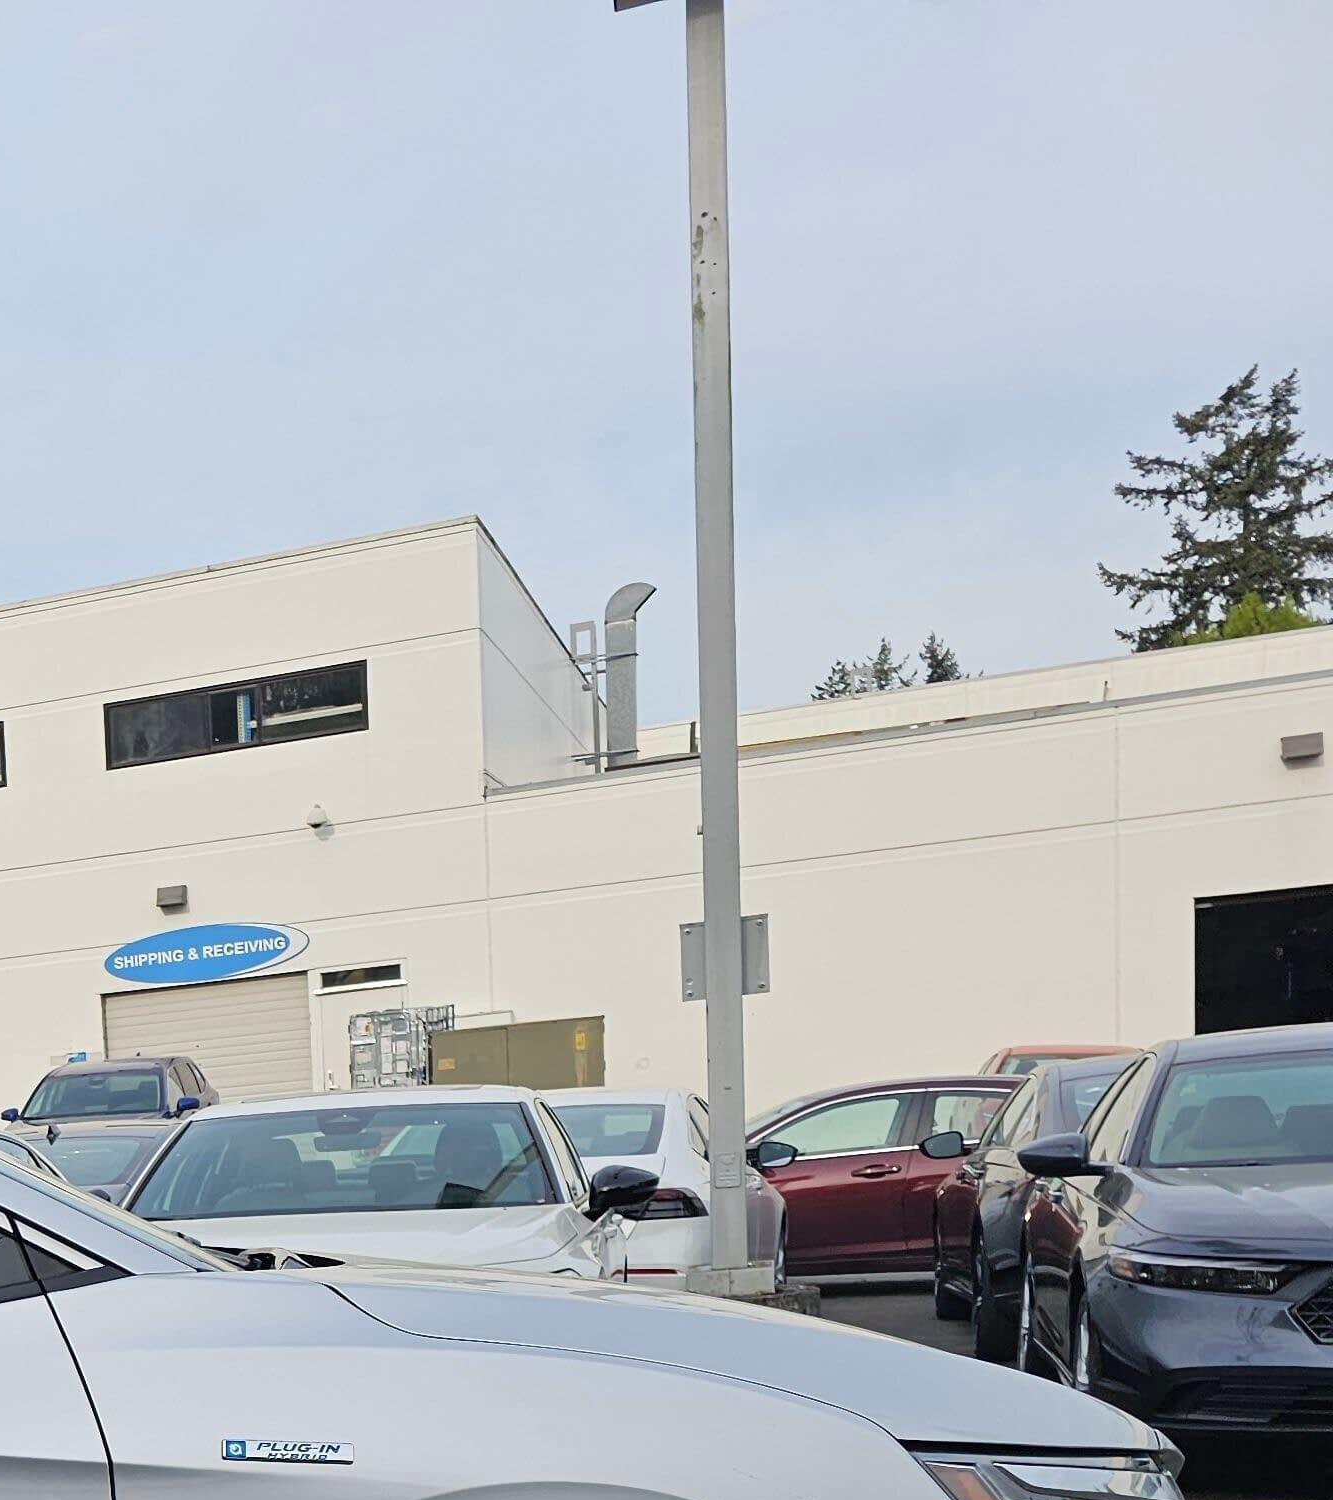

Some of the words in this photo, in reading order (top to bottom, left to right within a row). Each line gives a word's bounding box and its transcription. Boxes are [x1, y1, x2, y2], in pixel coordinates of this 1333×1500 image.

[113, 949, 184, 970] SHIPPING
[187, 947, 199, 961] &
[202, 936, 287, 959] RECEIVING
[256, 1442, 340, 1454] PLUG-IN
[267, 1453, 328, 1461] HYBRID
